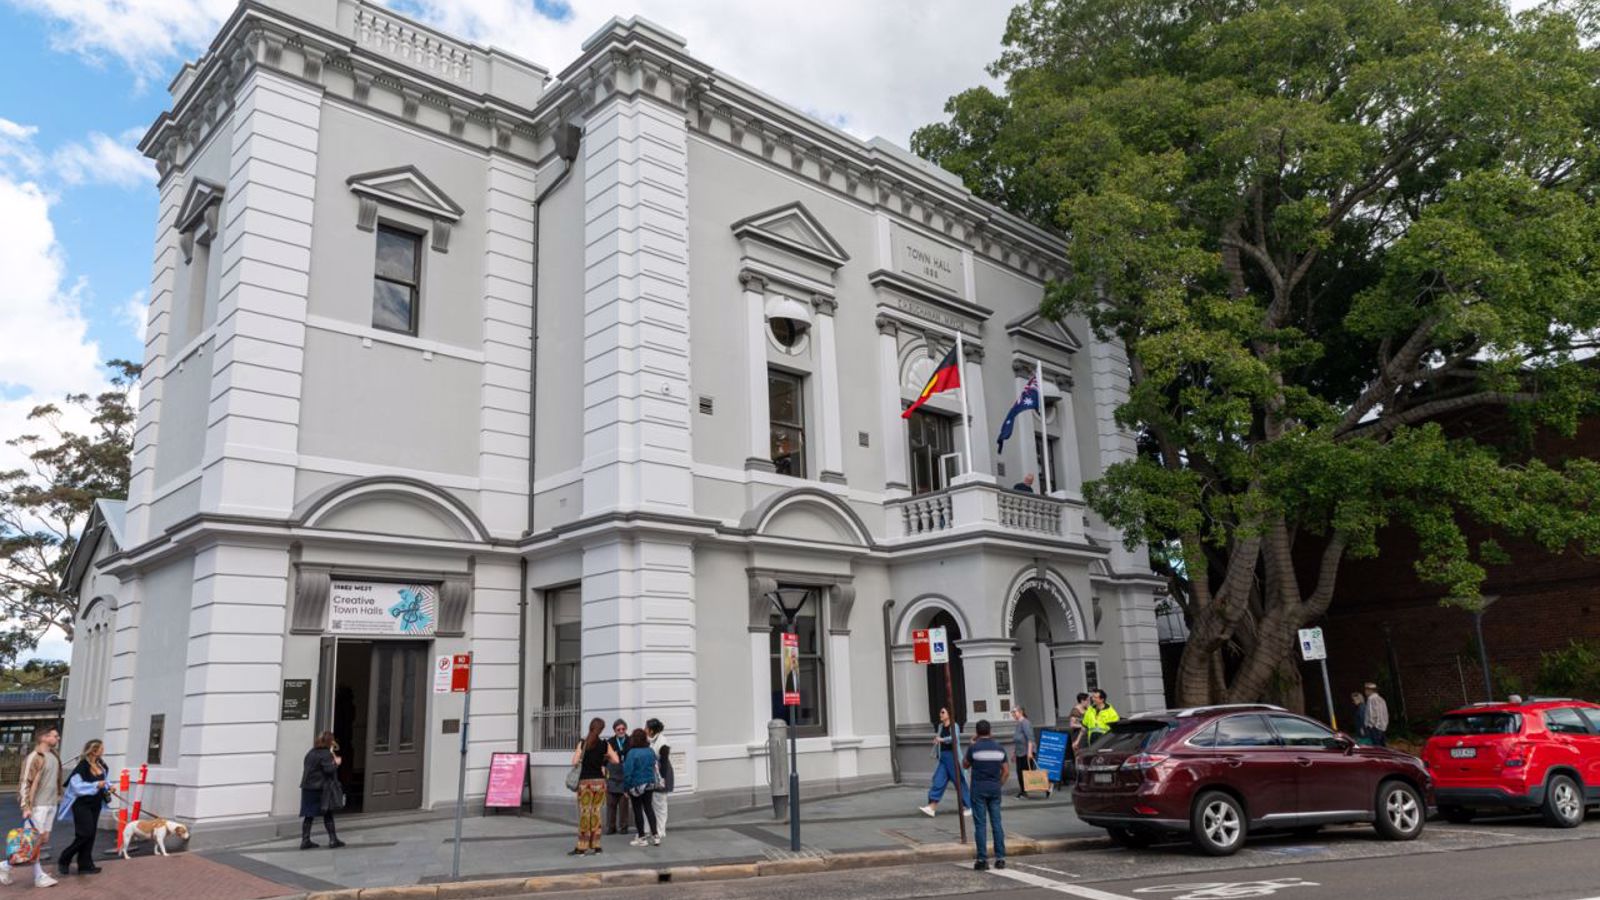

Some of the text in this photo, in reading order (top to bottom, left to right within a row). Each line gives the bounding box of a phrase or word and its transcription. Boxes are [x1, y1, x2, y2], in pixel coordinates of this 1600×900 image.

[907, 246, 951, 273] TOWN HALL
[333, 596, 375, 605] Creative
[333, 606, 383, 616] Town Halls
